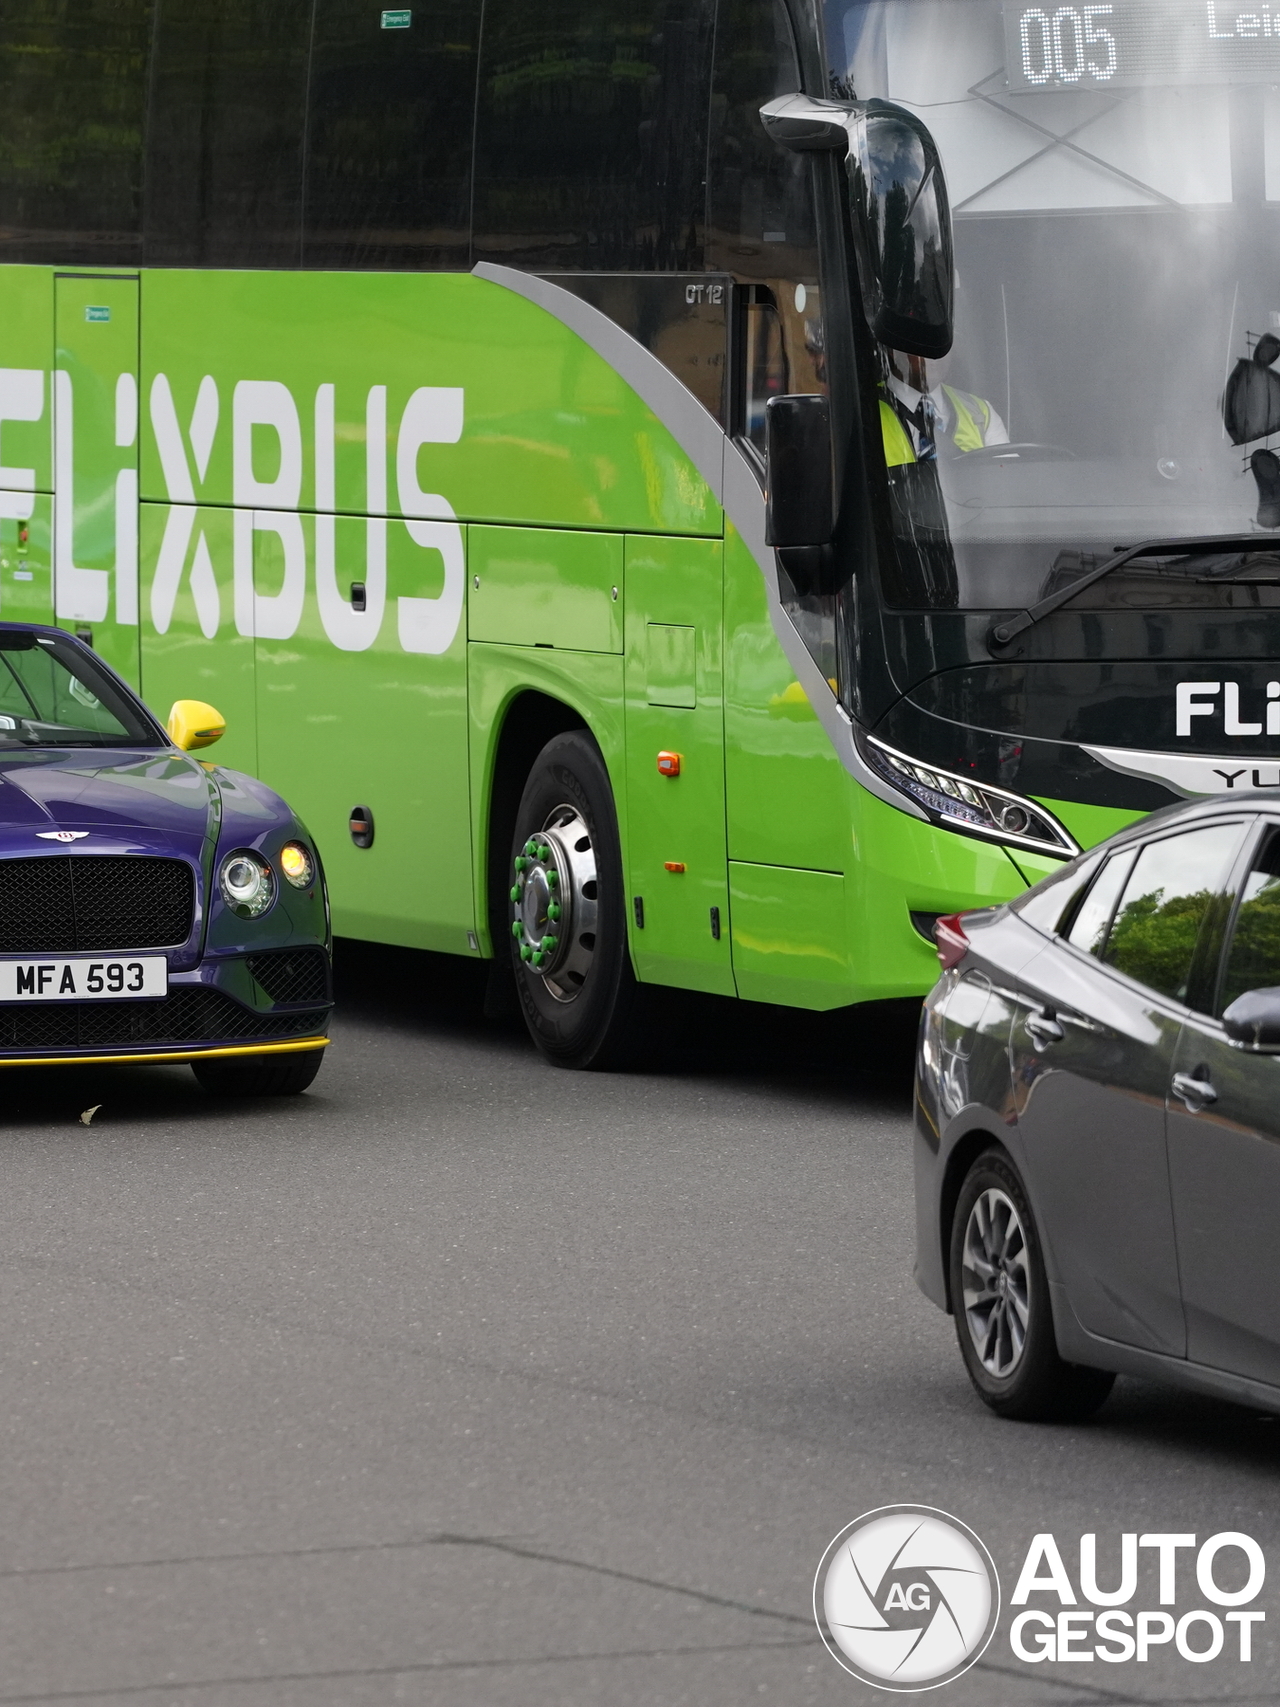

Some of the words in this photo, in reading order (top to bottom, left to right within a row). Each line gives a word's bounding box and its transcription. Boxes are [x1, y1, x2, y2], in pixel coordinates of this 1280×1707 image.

[1020, 4, 1117, 84] 005
[706, 284, 723, 304] 12
[16, 964, 76, 995] MFA
[86, 962, 144, 993] 593
